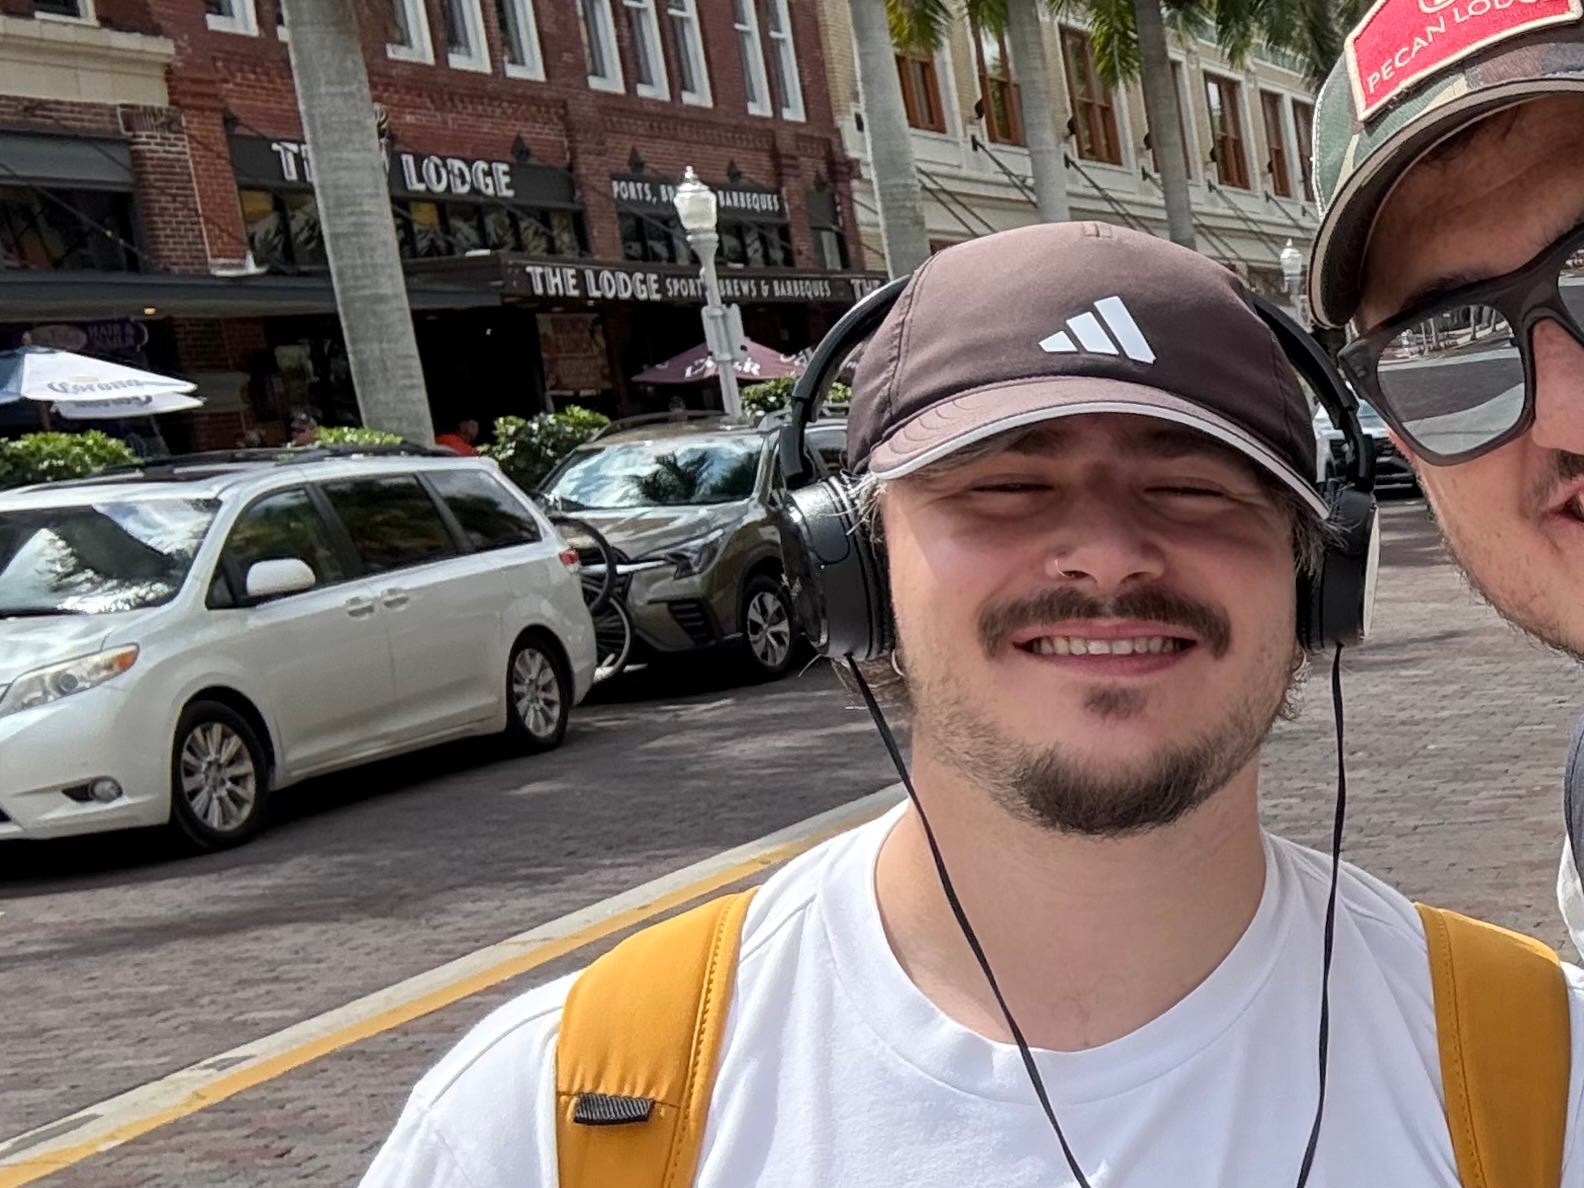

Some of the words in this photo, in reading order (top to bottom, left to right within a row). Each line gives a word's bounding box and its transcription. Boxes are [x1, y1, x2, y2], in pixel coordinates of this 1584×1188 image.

[1366, 16, 1446, 94] PECAN
[401, 153, 515, 198] LODGE
[526, 266, 580, 297] THE
[585, 269, 662, 301] LODGE
[761, 280, 769, 298] &
[773, 279, 832, 300] BARBEQUES
